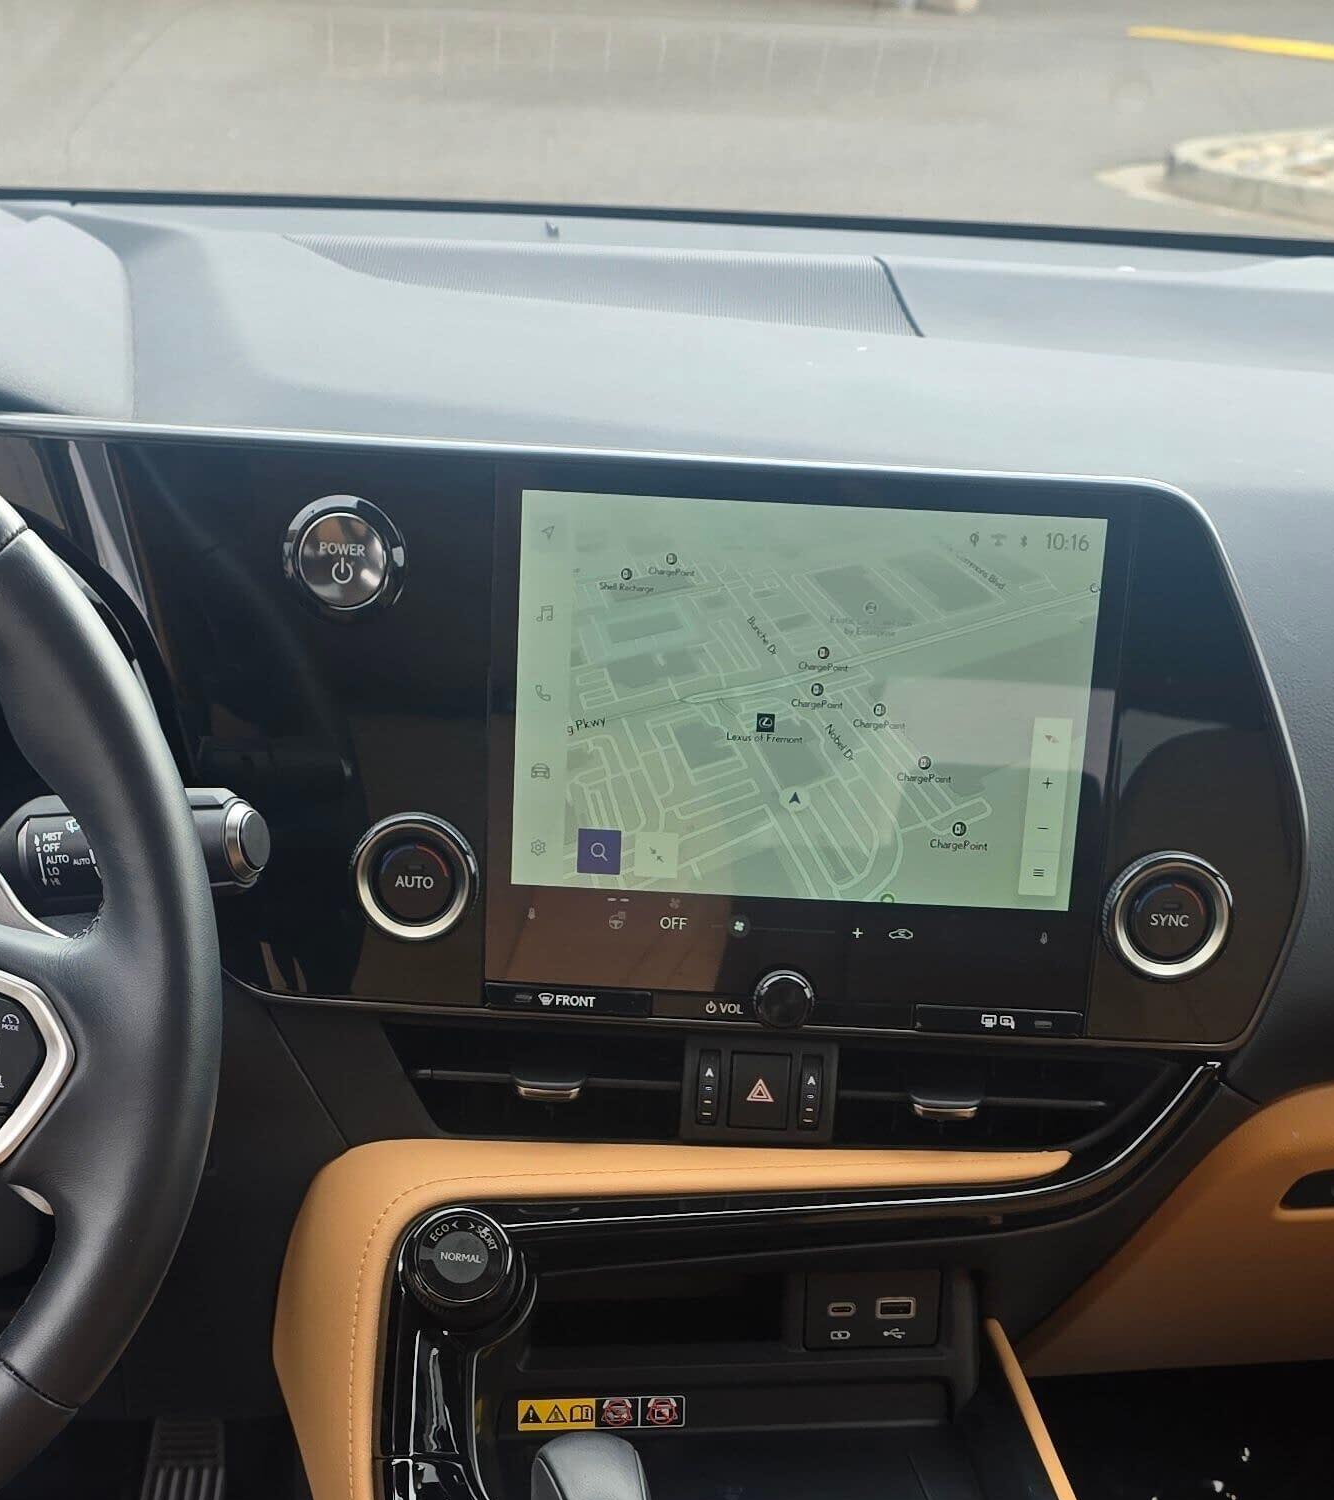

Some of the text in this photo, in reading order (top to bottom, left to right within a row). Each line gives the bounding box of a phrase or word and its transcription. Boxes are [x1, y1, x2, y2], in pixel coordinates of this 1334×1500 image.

[1046, 532, 1090, 552] 10:16
[319, 541, 366, 557] POWER
[599, 582, 617, 591] Shell
[798, 661, 849, 673] ChargePoint
[791, 698, 843, 710] ChargePoint
[575, 717, 606, 731] Pkwy
[853, 718, 906, 731] ChargePoint
[726, 732, 803, 745] Lexus of Fremont
[825, 723, 855, 762] Nobel Dr
[896, 773, 952, 785] ChargePoint
[42, 831, 63, 843] MIST
[43, 843, 60, 853] OFF
[929, 838, 988, 851] ChargePoint
[45, 854, 69, 865] AUTO
[73, 857, 91, 867] AUTO
[48, 867, 59, 876] LO
[395, 875, 434, 890] AUTO
[659, 916, 688, 930] OFF
[1150, 914, 1189, 928] SYNC
[555, 994, 596, 1008] FRONT
[719, 1003, 744, 1014] VOL
[1, 1023, 19, 1032] MODE
[429, 1223, 450, 1242] ECO
[440, 1251, 482, 1264] NORMAL
